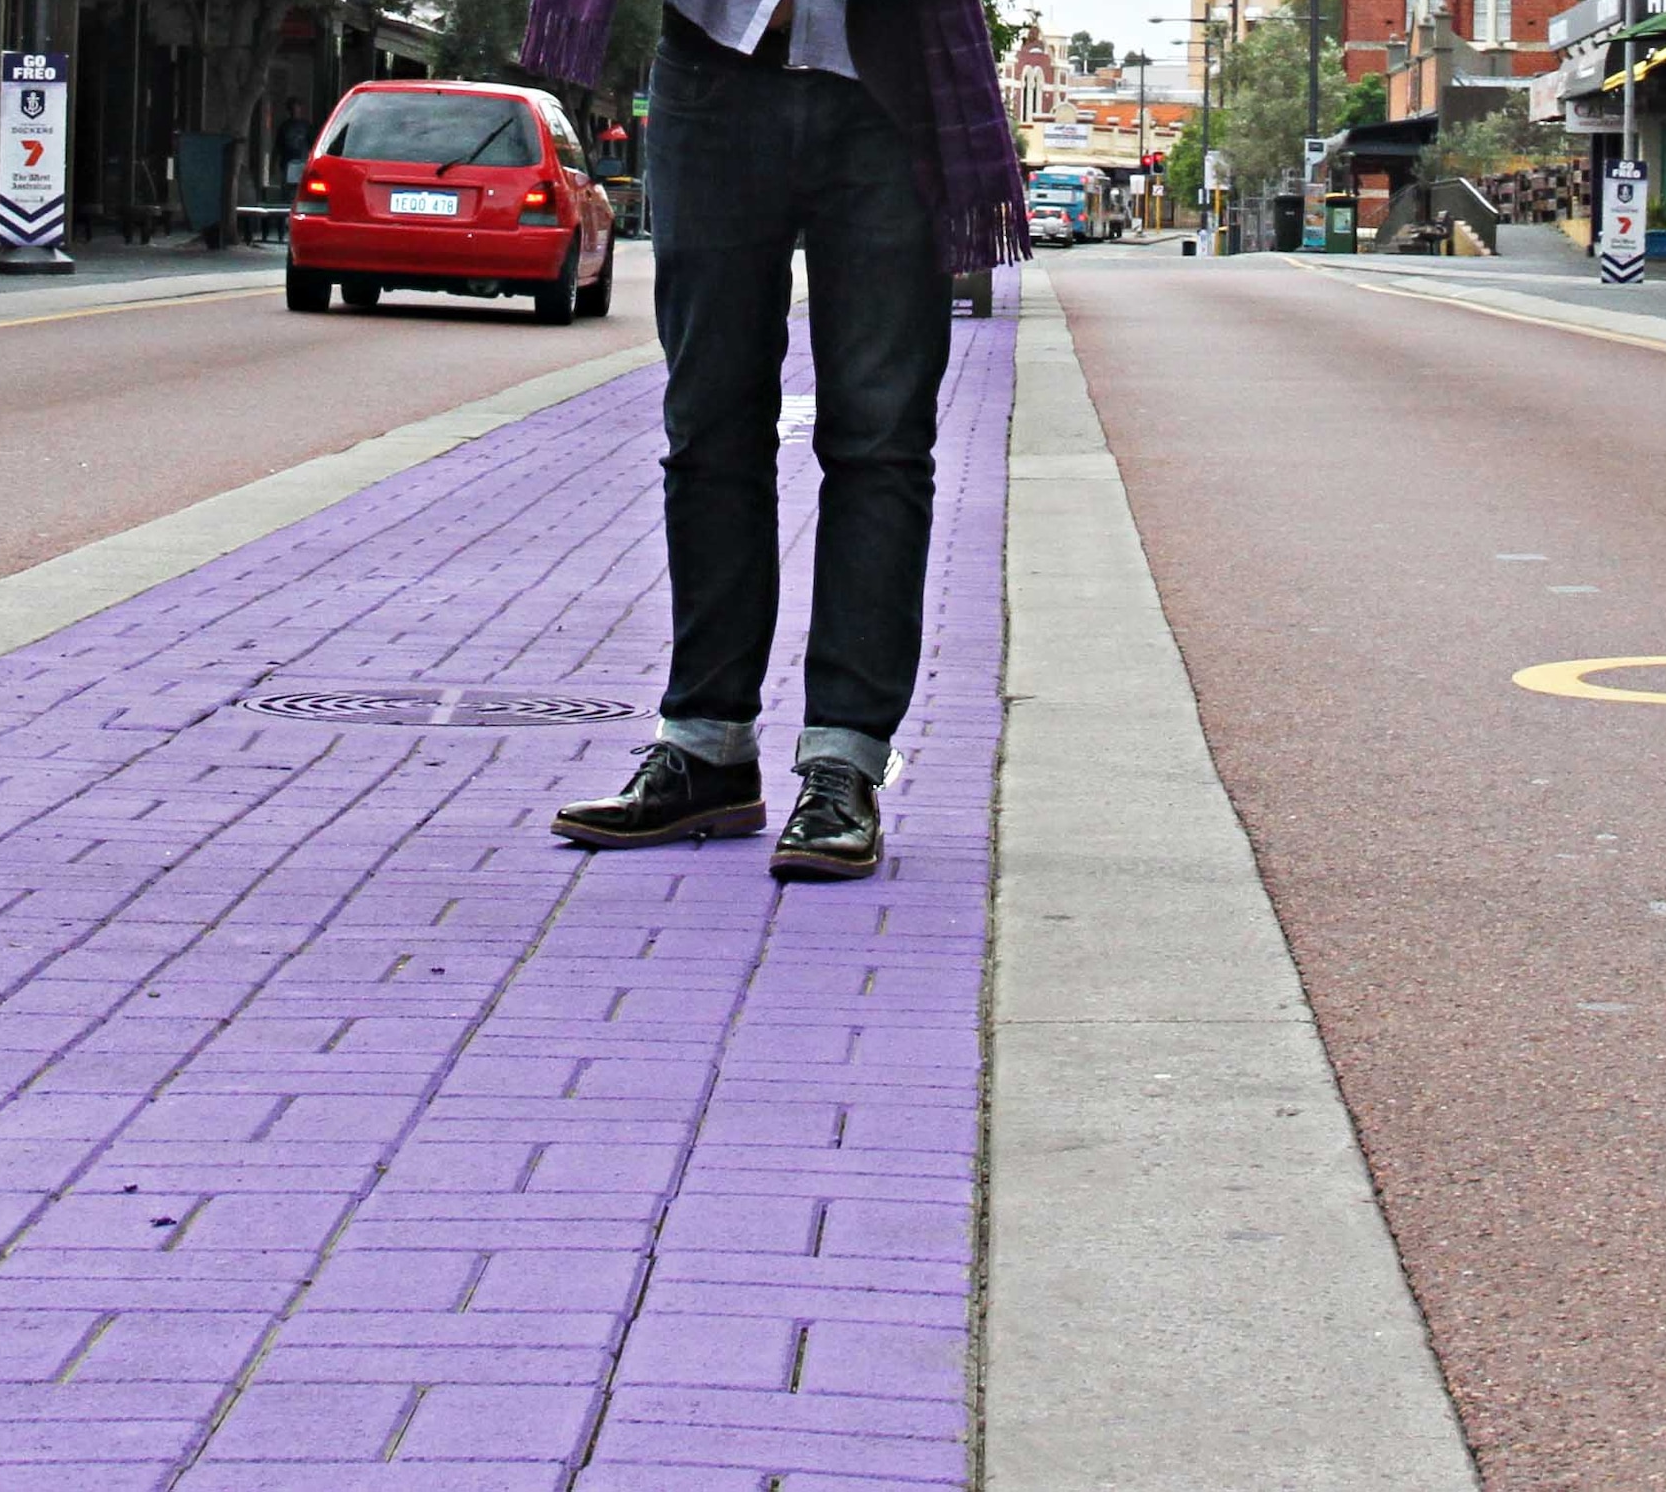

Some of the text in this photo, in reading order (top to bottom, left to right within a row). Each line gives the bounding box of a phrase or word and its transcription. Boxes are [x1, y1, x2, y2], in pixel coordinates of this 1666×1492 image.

[23, 54, 47, 68] GO
[13, 67, 57, 80] FREO
[21, 139, 45, 167] 7
[1619, 161, 1635, 170] GO
[1612, 169, 1642, 179] FREO
[1617, 216, 1632, 235] 7
